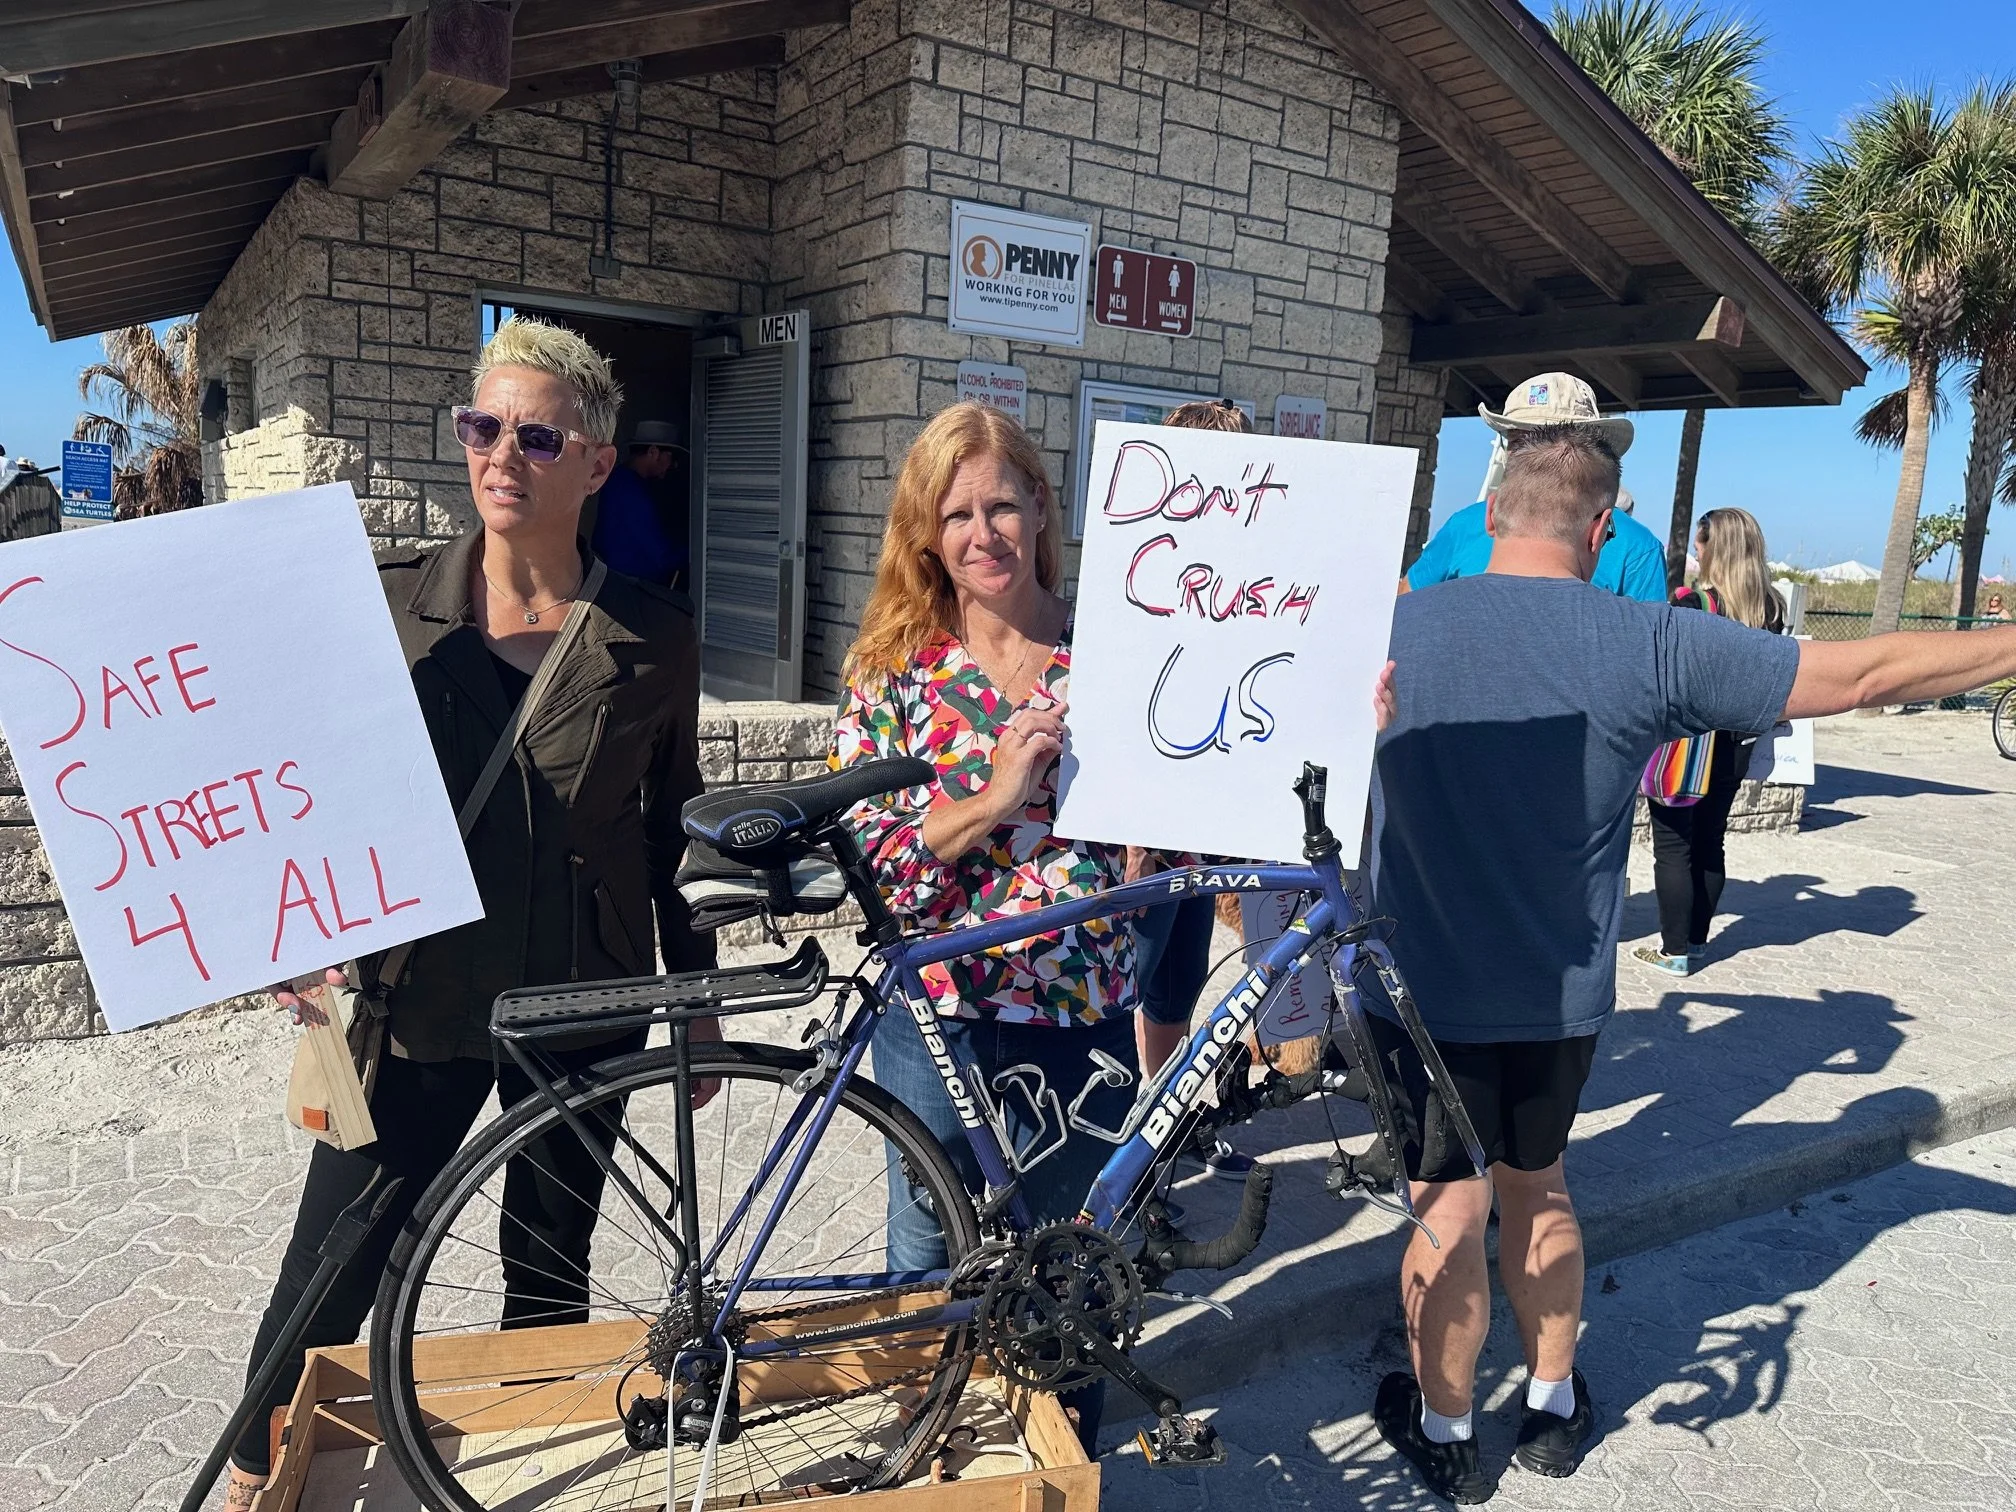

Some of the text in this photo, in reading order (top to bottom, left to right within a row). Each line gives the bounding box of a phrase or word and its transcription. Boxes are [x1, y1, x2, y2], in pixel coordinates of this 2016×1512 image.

[1005, 243, 1080, 281] PENNY
[965, 279, 1075, 305] WORKING FOR YOU
[1004, 273, 1076, 292] FOR PINELLAS
[980, 295, 1059, 312] www.tipenny.com
[1109, 293, 1127, 310] MEN
[1159, 301, 1187, 319] WOMEN
[761, 314, 796, 343] MEN
[960, 372, 1024, 391] ALCOHOL PROHIBITED
[993, 394, 1019, 408] WITHIN
[82, 502, 111, 510] PROTECT
[1126, 533, 1319, 626] CRUSH
[0, 576, 216, 749] SAFE
[55, 761, 314, 891] STREETS
[732, 821, 751, 832] selle
[734, 822, 775, 844] ITALIA
[1169, 872, 1261, 894] BRAVA
[124, 846, 421, 981] 4 ALL
[910, 997, 984, 1129] Bianchi
[1140, 968, 1270, 1151] Bianchi
